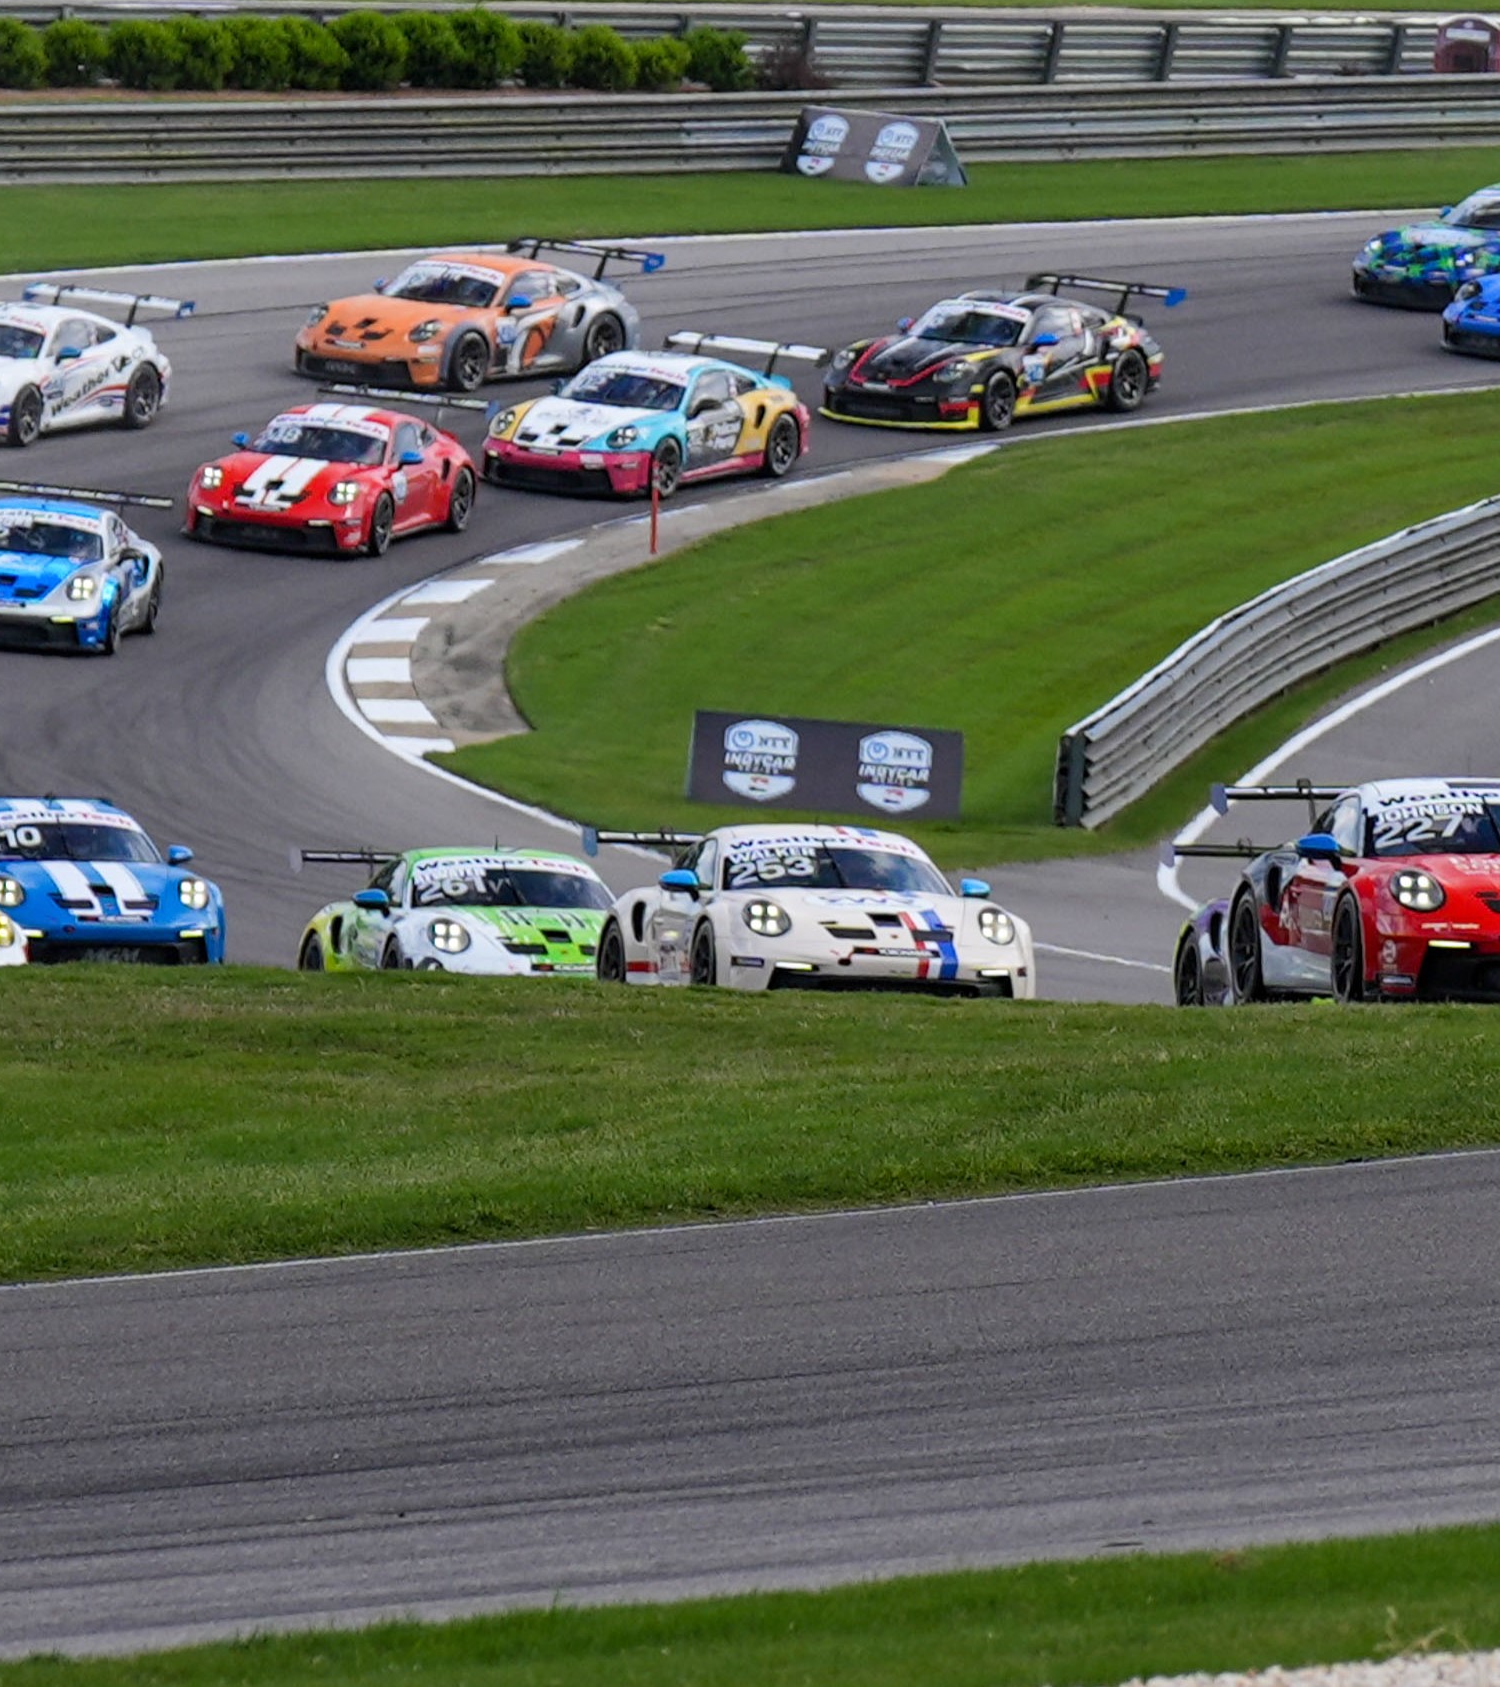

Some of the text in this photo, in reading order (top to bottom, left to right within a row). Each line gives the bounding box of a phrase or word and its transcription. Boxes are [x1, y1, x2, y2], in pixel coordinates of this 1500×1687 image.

[759, 735, 791, 749] NTT
[724, 752, 797, 771] INDYCAR
[893, 746, 925, 761] NTT
[858, 763, 930, 782] INDYCAR
[1375, 802, 1485, 825] JOHNSON
[1373, 813, 1464, 850] 227
[730, 835, 916, 855] WeatherTech
[728, 846, 816, 864] WALKER
[416, 856, 588, 875] WeatherTech
[729, 856, 815, 887] 253
[417, 874, 487, 904] 261
